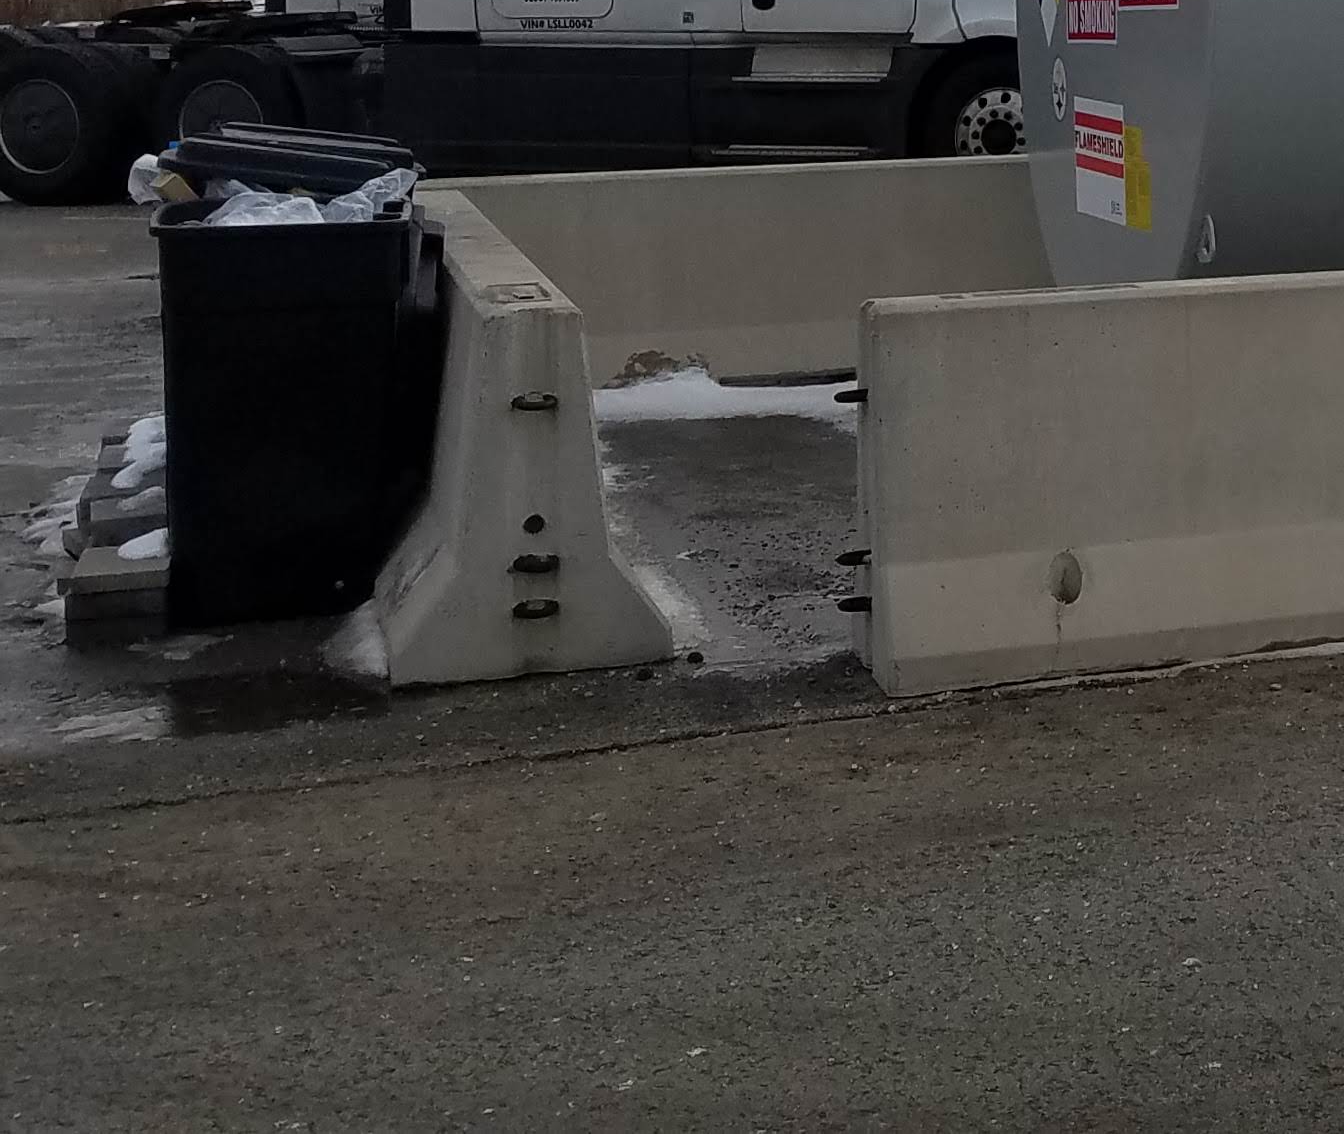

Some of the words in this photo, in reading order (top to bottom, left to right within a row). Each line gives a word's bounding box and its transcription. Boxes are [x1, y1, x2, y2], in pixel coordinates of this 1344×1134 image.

[520, 20, 545, 29] VIN#
[1068, 0, 1078, 34] NO
[1080, 0, 1114, 34] SMOKING
[1074, 130, 1124, 159] FLAMESHIELD
